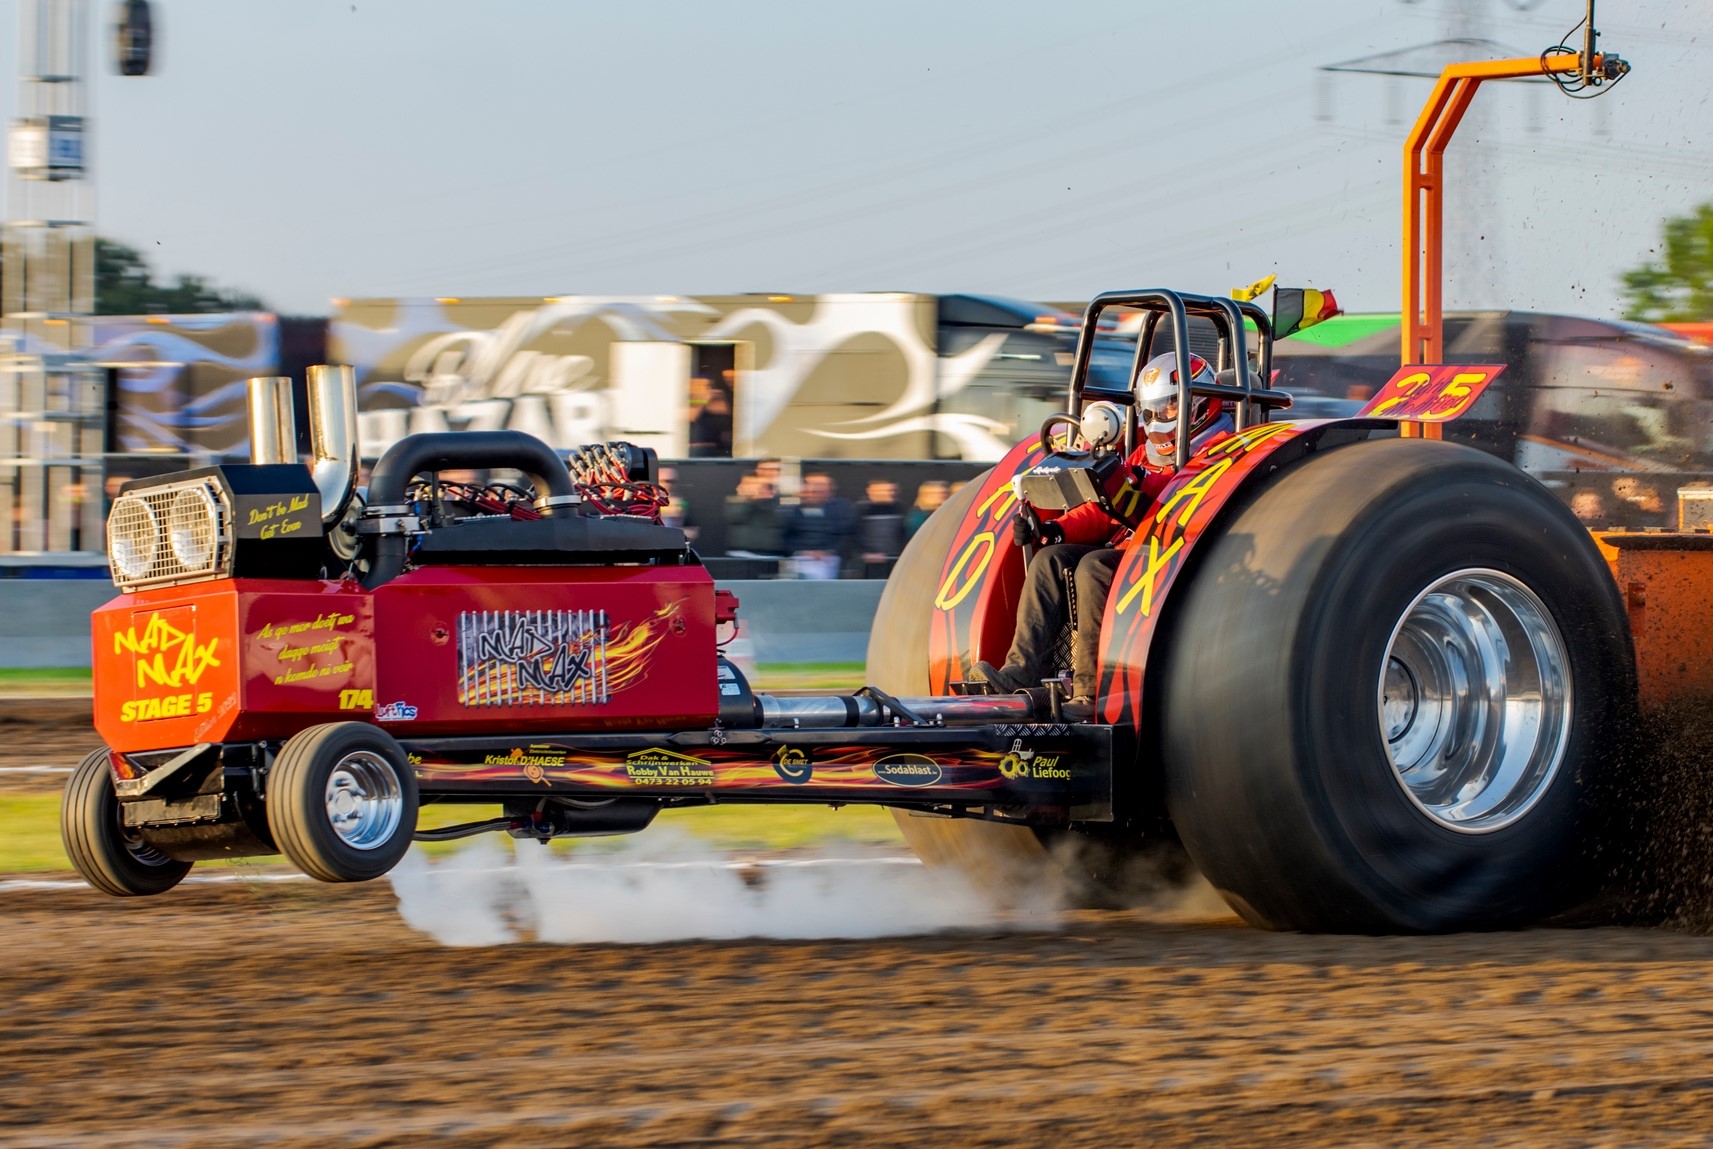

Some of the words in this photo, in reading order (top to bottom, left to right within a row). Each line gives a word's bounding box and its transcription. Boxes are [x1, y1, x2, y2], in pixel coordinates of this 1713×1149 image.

[281, 519, 302, 534] Even
[114, 612, 186, 655] MAD
[480, 617, 554, 662] MAD
[137, 633, 221, 688] MAX
[517, 643, 590, 692] MAX
[120, 694, 192, 722] STAGE
[197, 692, 213, 713] 5
[338, 689, 374, 710] 174
[484, 754, 519, 766] Kristof
[520, 755, 565, 767] D'HAESE
[626, 765, 658, 777] Robby
[658, 765, 680, 776] Van
[680, 766, 714, 776] Hauwe
[1033, 756, 1060, 767] Paul
